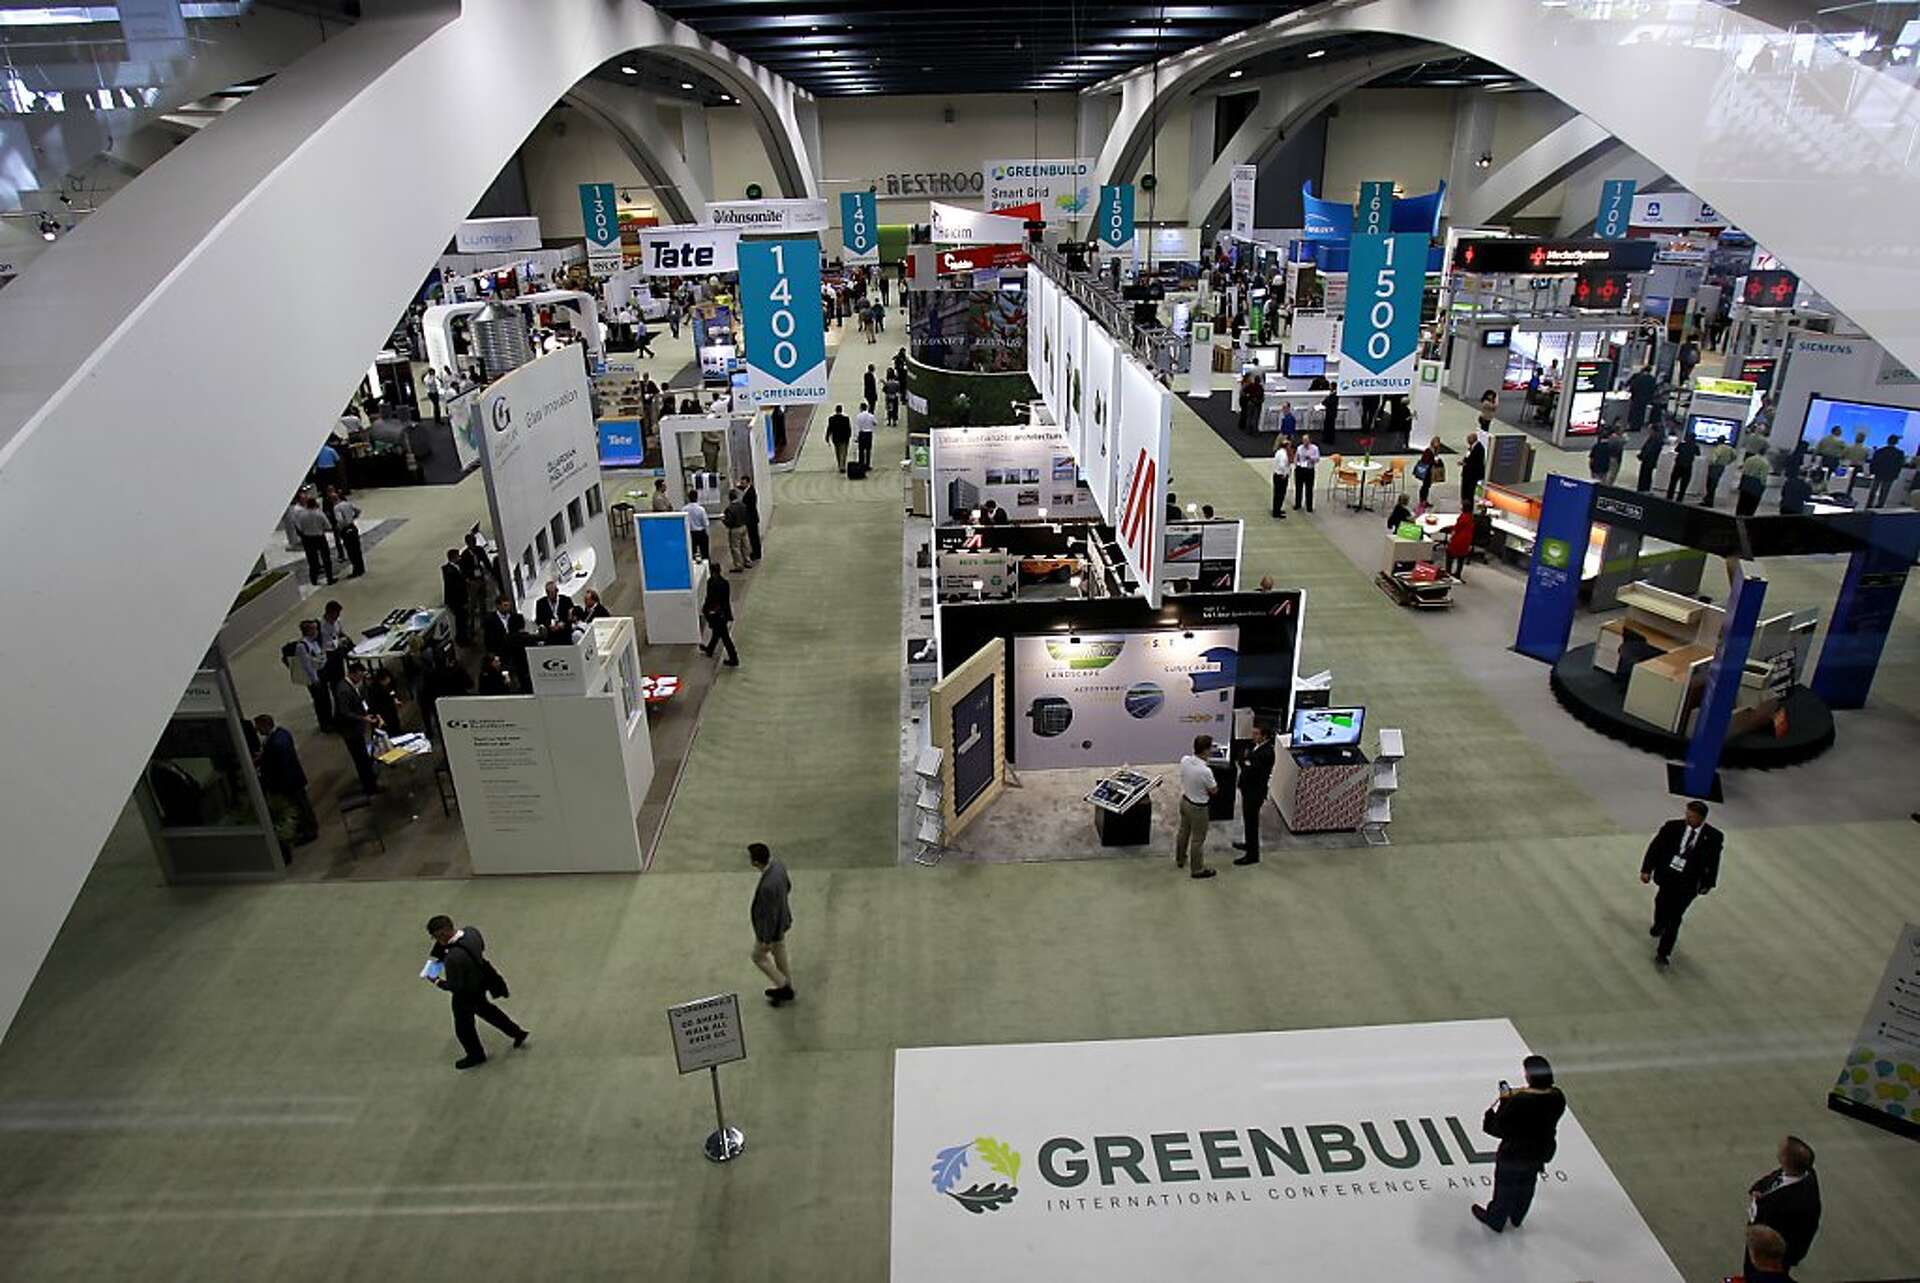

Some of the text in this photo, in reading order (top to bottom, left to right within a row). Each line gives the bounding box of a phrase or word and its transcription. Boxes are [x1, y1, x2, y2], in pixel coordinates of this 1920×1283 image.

[886, 171, 984, 195] RESTROO
[1007, 164, 1087, 177] GREENBUILD
[592, 185, 608, 242] 1300
[991, 187, 1024, 199] Smart
[1111, 187, 1122, 241] 1500
[1367, 183, 1380, 235] 1600
[1606, 183, 1622, 236] 1700
[854, 194, 867, 249] 1400
[650, 240, 714, 269] Tate
[769, 244, 798, 370] 1400
[1367, 236, 1396, 360] 1500
[1799, 341, 1852, 355] SIEMENS
[763, 387, 826, 399] GREENBUILD
[1351, 377, 1411, 388] GREENBUILD
[608, 434, 632, 446] Tate
[1038, 1116, 1498, 1188] GREENBUIL
[1047, 1169, 1568, 1212] INTERNATIONAL CONFERENCE AND PO
